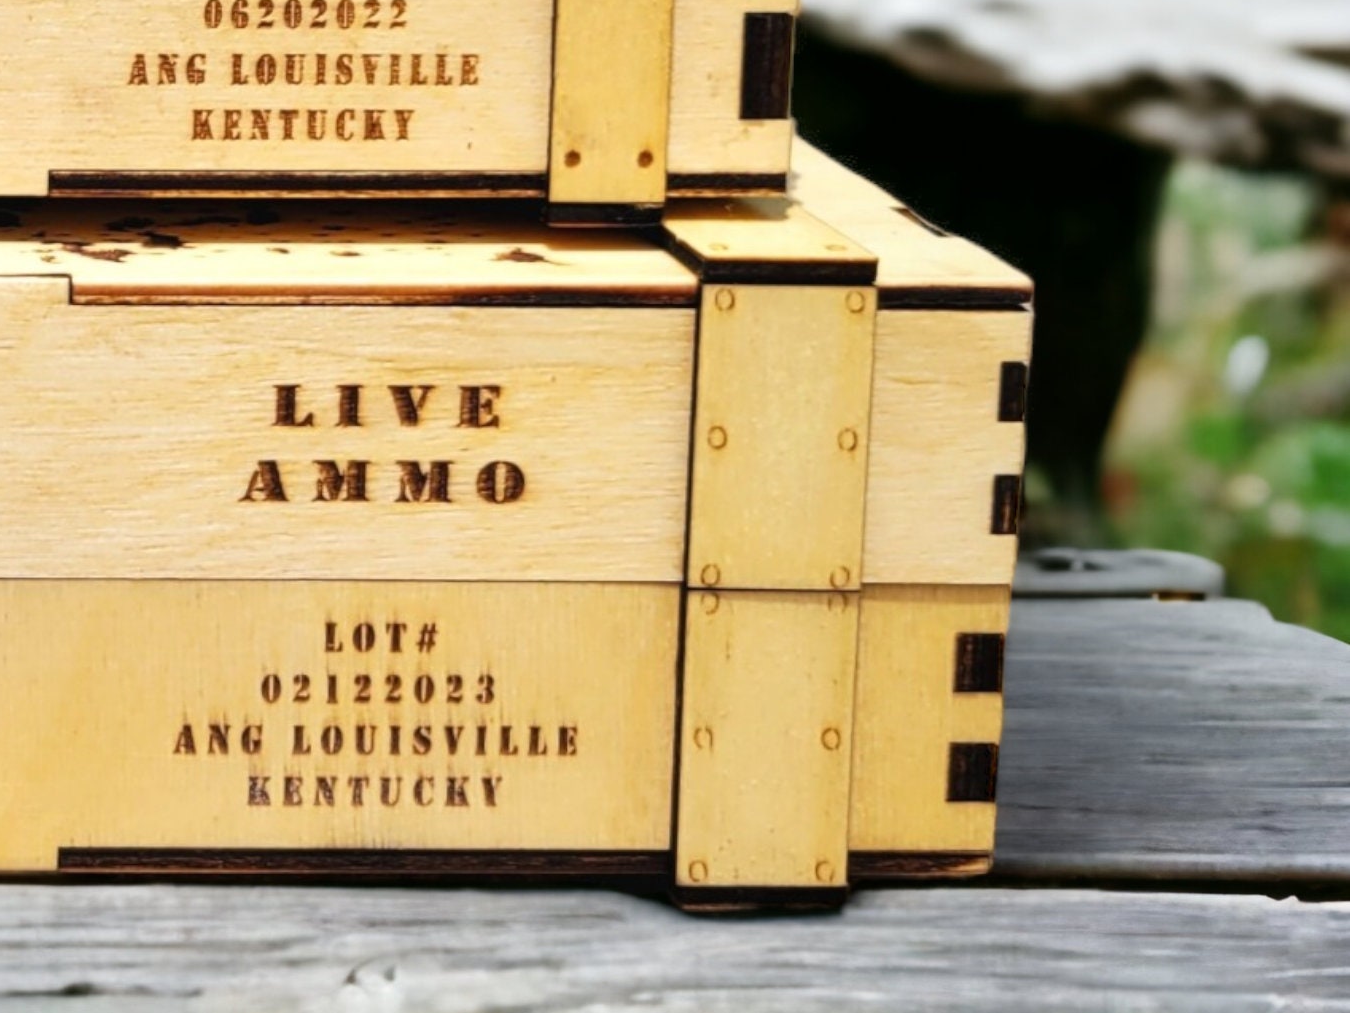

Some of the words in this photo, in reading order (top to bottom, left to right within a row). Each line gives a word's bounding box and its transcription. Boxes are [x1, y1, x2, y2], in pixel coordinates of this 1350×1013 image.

[128, 54, 207, 86] ANG
[230, 54, 480, 86] LOUISVILLE
[191, 109, 416, 141] KENTUCKY
[272, 384, 502, 428] LIVE
[238, 460, 526, 504] AMMO
[325, 622, 439, 653] LOT#
[260, 674, 496, 705] 02122023
[174, 724, 263, 756] ANG
[292, 724, 580, 756] LOUISVILLE
[247, 776, 505, 807] KENTUCKY
